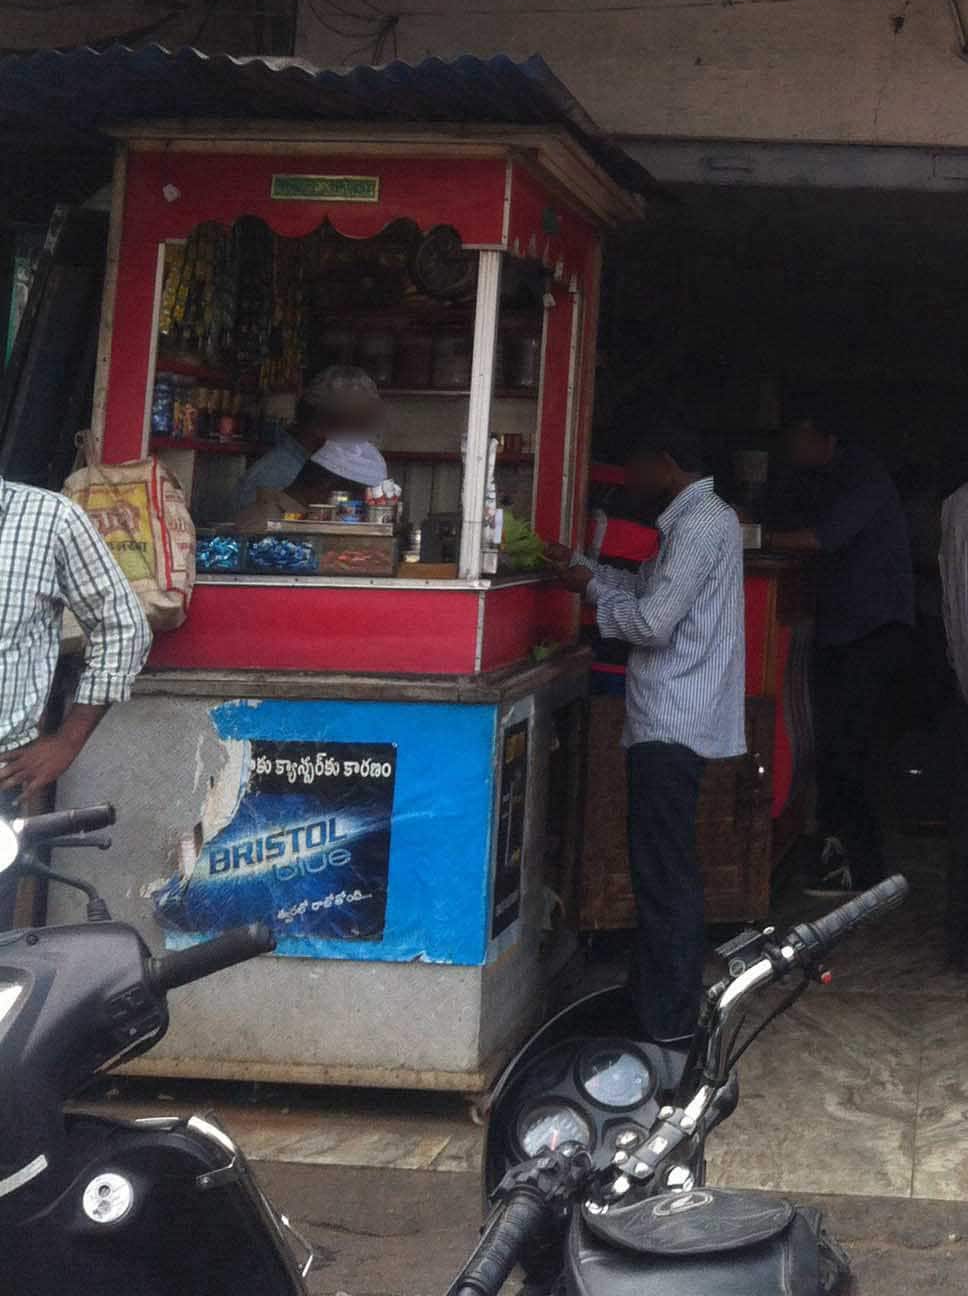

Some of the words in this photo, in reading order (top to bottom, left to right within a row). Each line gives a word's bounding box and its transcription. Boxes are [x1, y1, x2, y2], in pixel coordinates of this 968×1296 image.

[343, 758, 392, 778] కారణం
[208, 817, 347, 875] BRISTOL
[272, 848, 352, 882] blue
